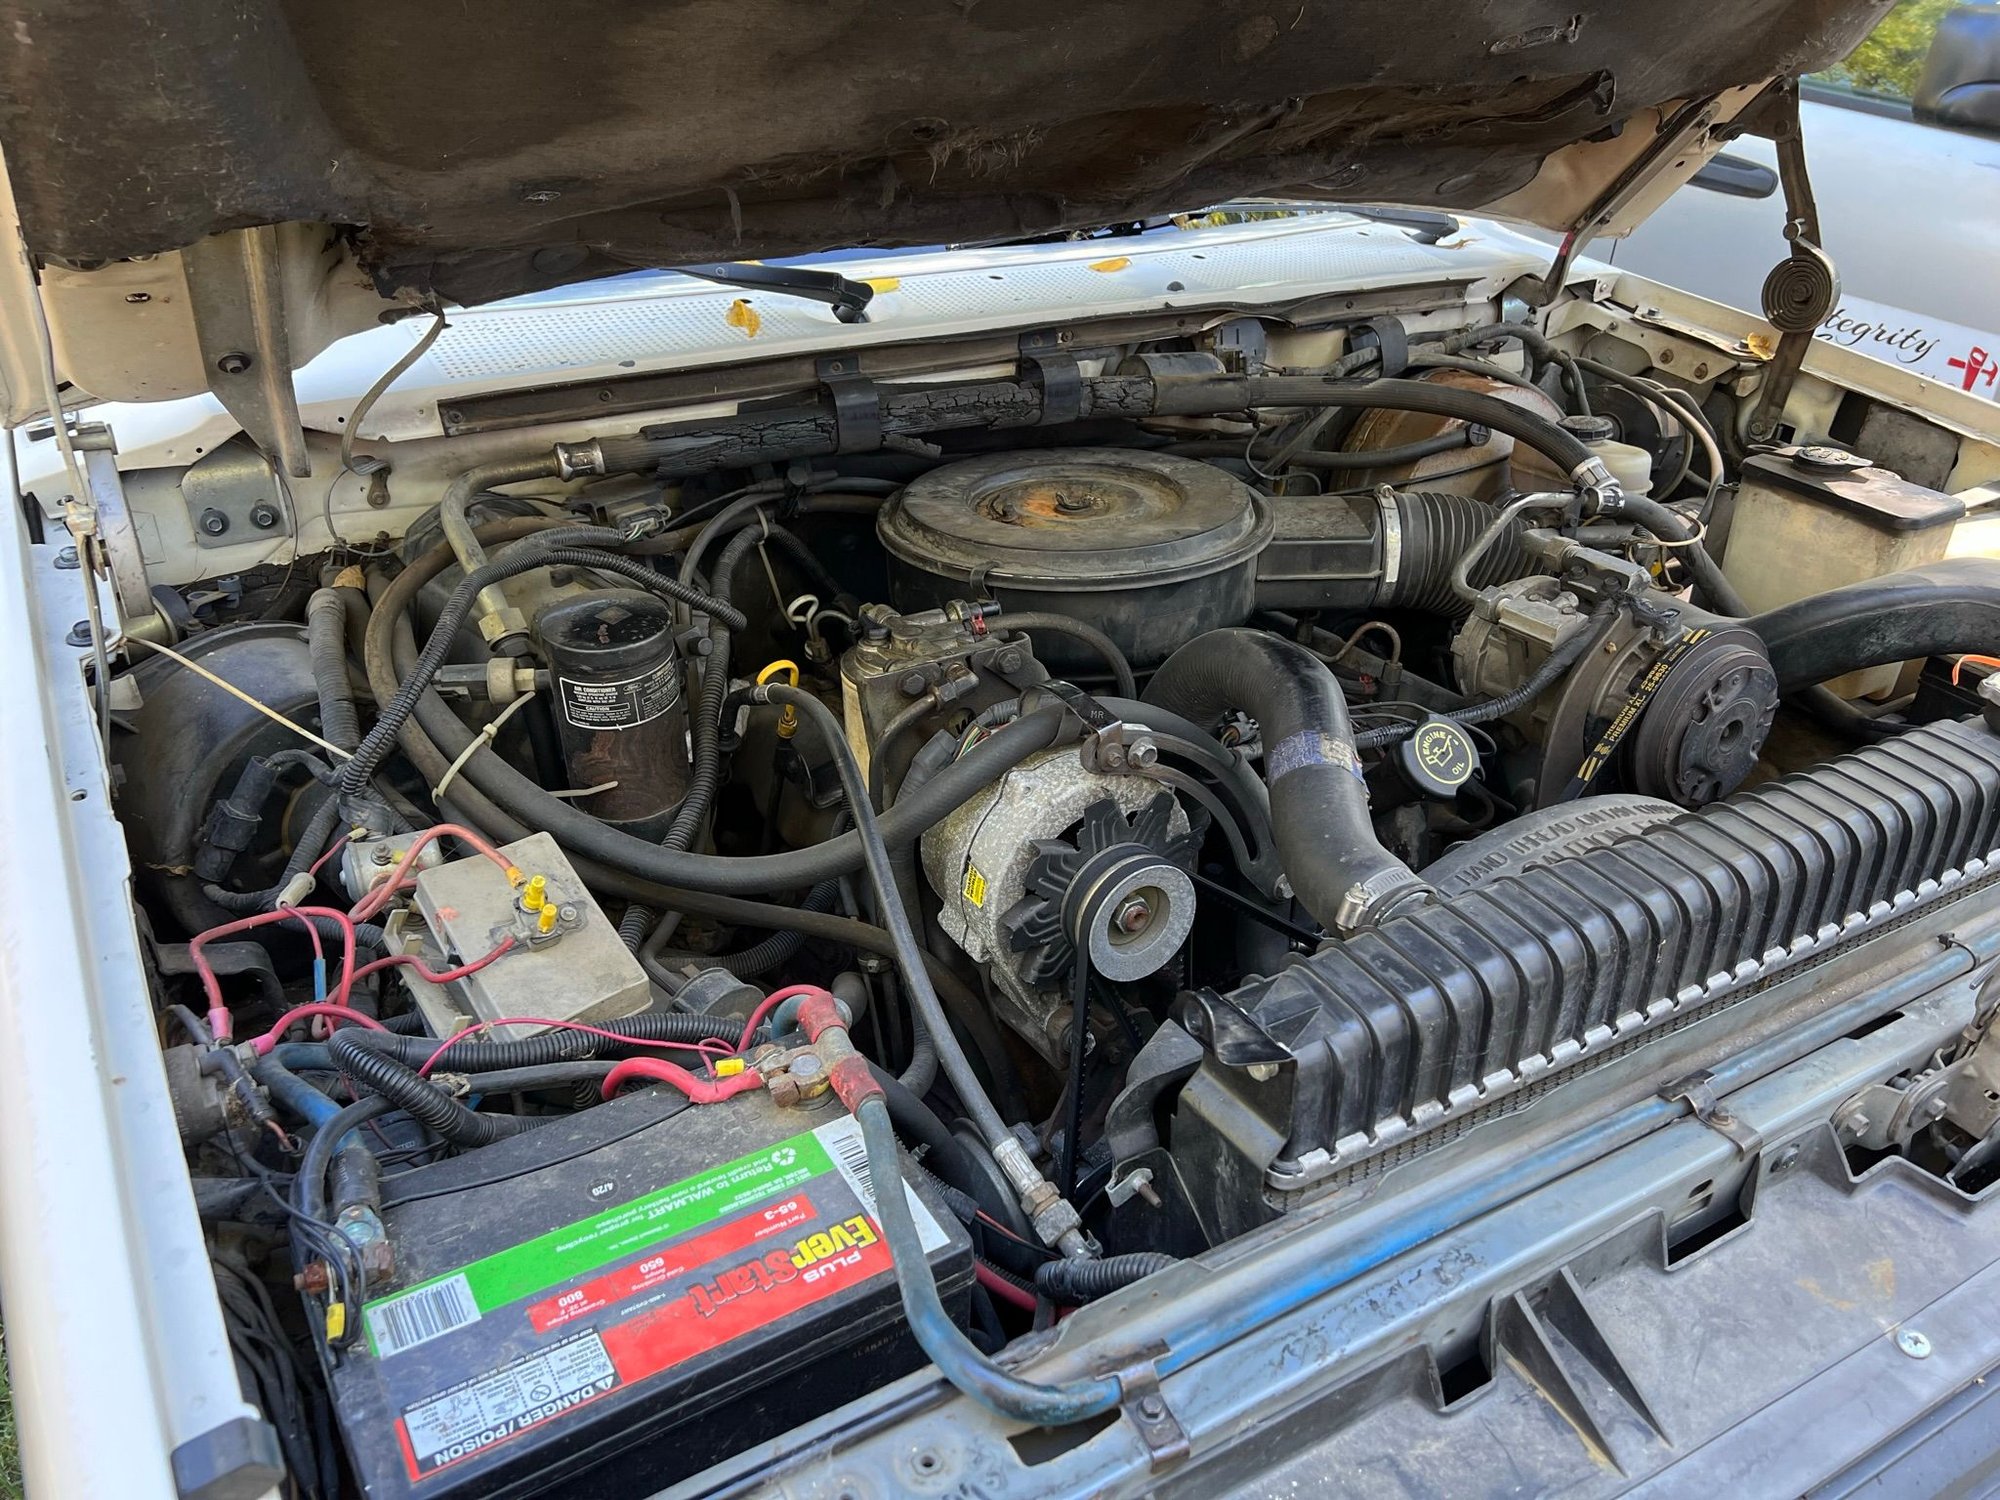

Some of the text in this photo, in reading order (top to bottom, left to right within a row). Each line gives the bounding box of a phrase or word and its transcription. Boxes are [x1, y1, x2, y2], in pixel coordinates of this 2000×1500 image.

[1824, 308, 1940, 364] tegrity
[1608, 707, 1637, 742] PREMIUM
[1422, 730, 1446, 755] ENGINE
[1451, 761, 1464, 775] OIL
[716, 1180, 729, 1189] to
[731, 1162, 773, 1183] Return
[592, 1182, 613, 1196] 4/20
[649, 1187, 714, 1219] WALMART
[763, 1201, 797, 1220] 65-3
[640, 1257, 664, 1273] 650
[687, 1213, 878, 1319] EverStart
[801, 1250, 862, 1284] PLUS
[558, 1290, 584, 1307] 800
[518, 1386, 595, 1426] DANGER
[434, 1425, 506, 1466] POISON
